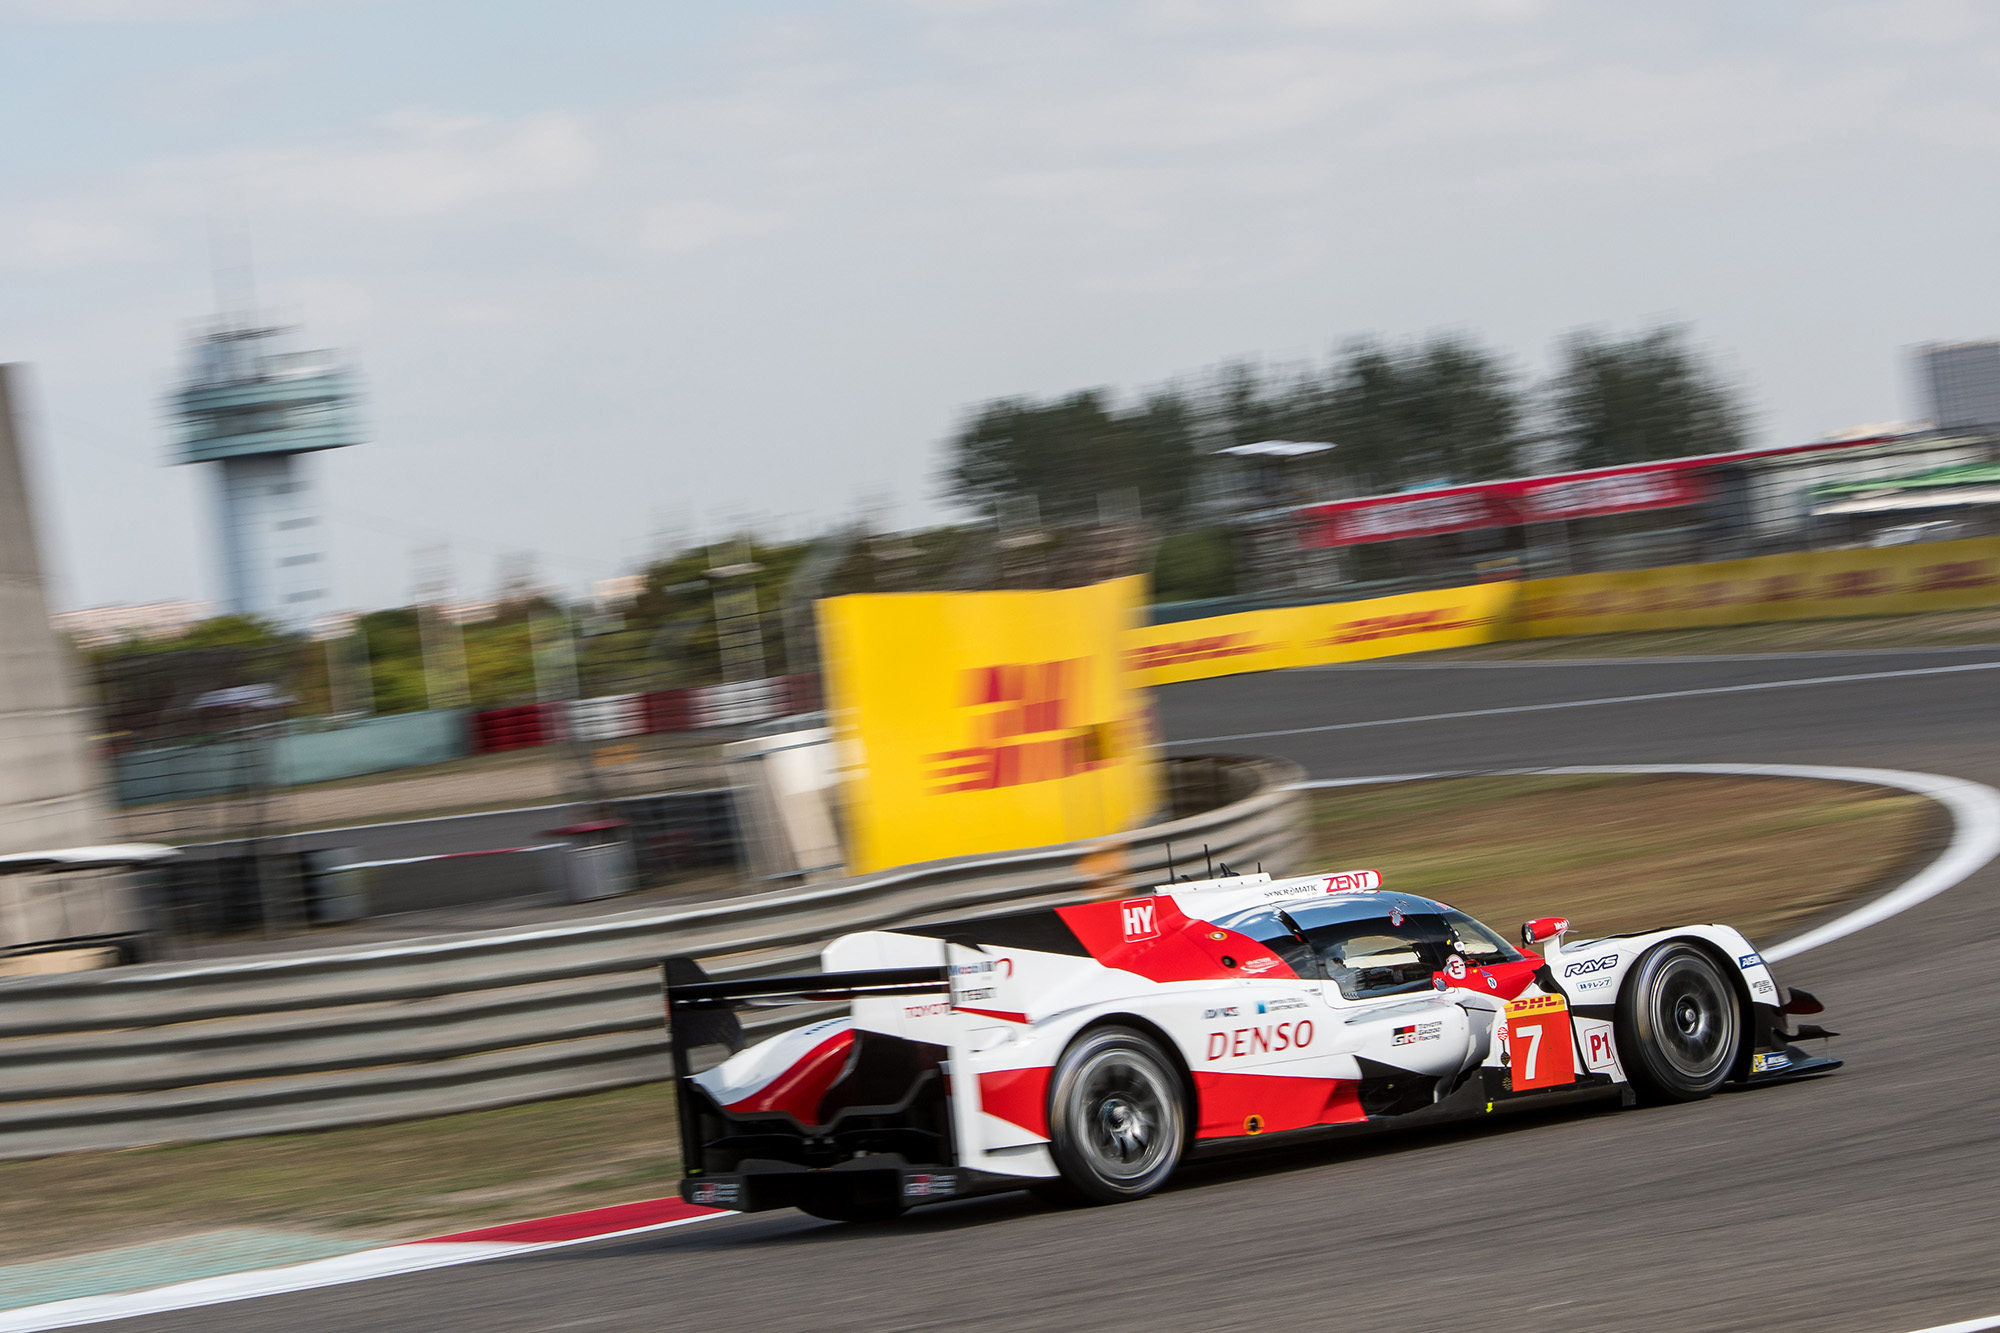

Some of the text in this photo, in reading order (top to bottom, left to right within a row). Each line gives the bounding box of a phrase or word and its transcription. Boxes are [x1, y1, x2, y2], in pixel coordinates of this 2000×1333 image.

[1322, 872, 1369, 893] ZENT
[1123, 905, 1153, 935] HY
[1565, 954, 1619, 978] RAYS
[1511, 996, 1557, 1012] DHL
[1206, 1019, 1314, 1061] DENSO
[1516, 1024, 1543, 1080] 7
[1590, 1032, 1611, 1062] P1
